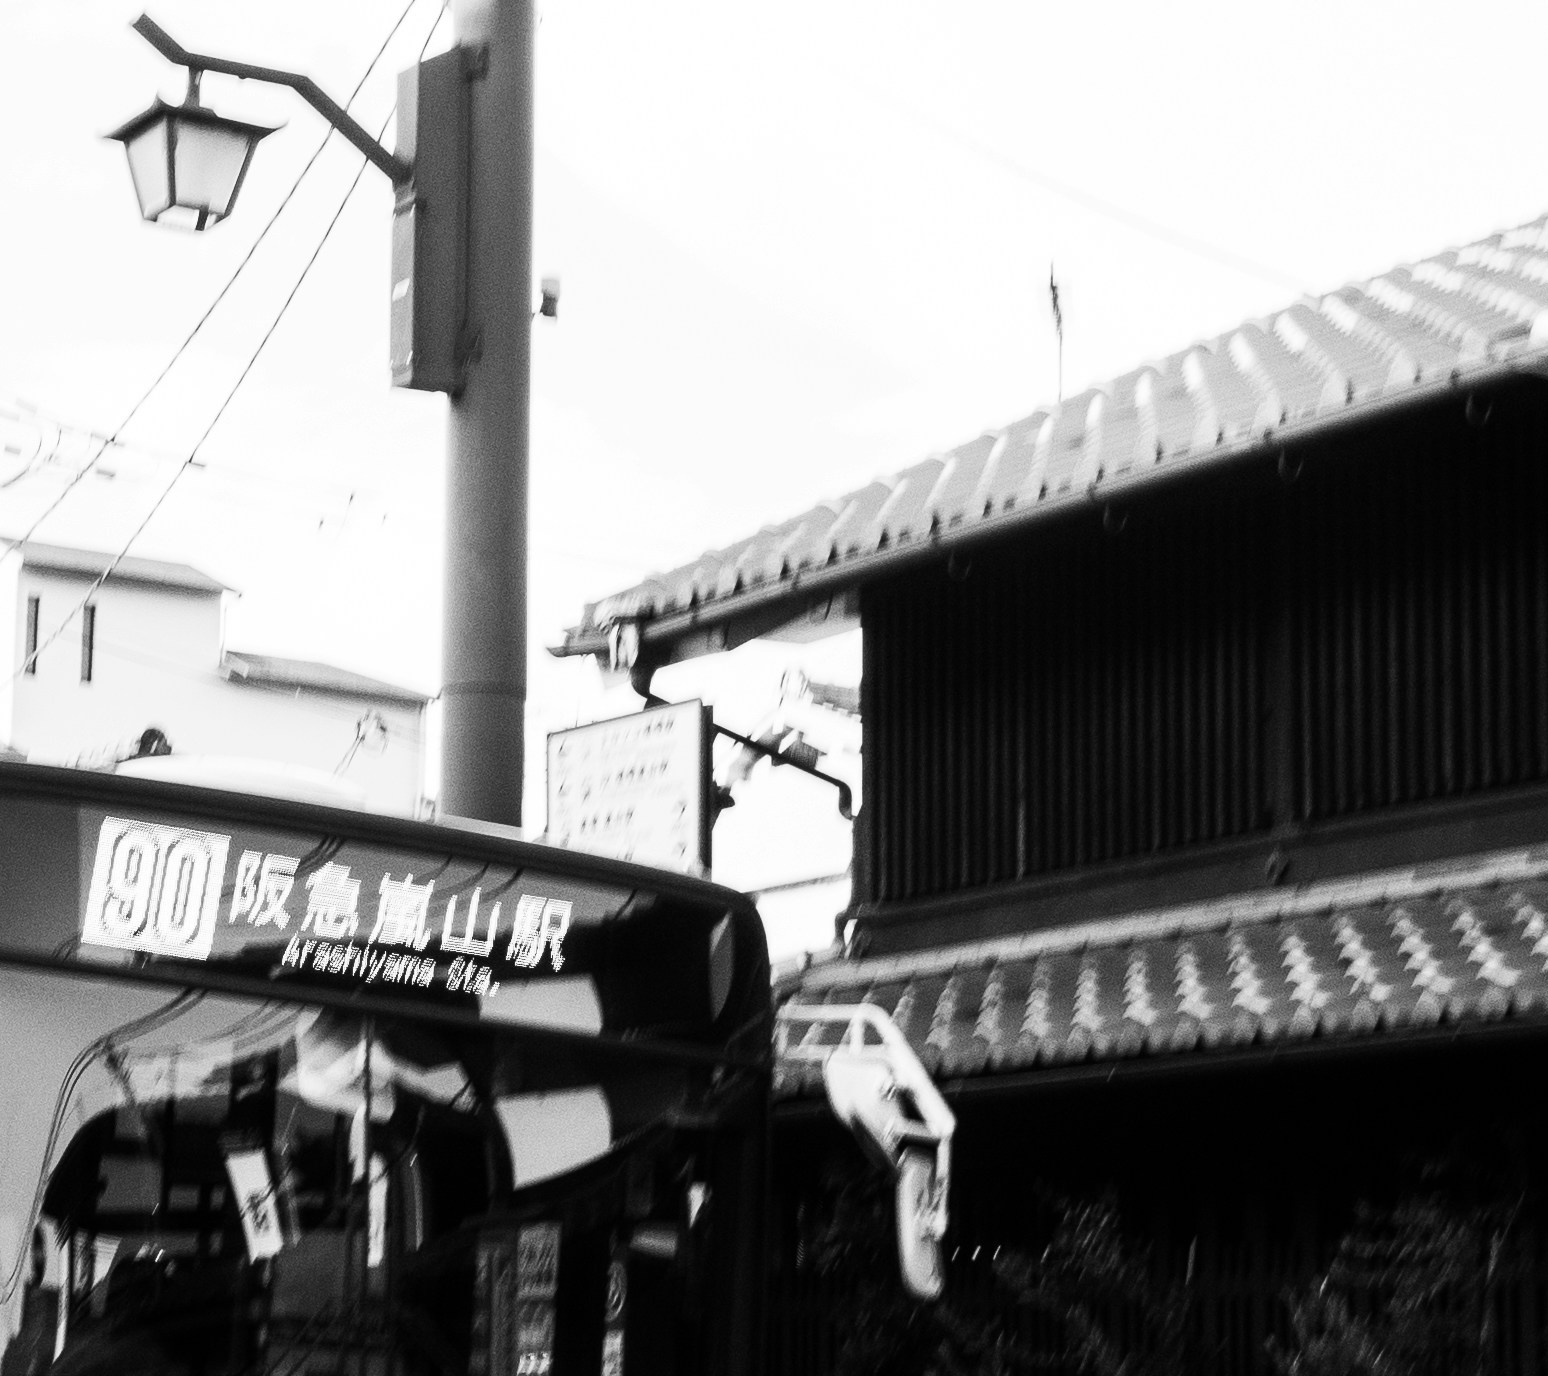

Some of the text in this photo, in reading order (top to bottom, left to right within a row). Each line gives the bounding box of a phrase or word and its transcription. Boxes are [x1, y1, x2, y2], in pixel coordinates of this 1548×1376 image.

[94, 823, 220, 951] 90
[229, 849, 573, 973] 阪急嵐山駅
[281, 930, 501, 998] Arashiyama Sta.
